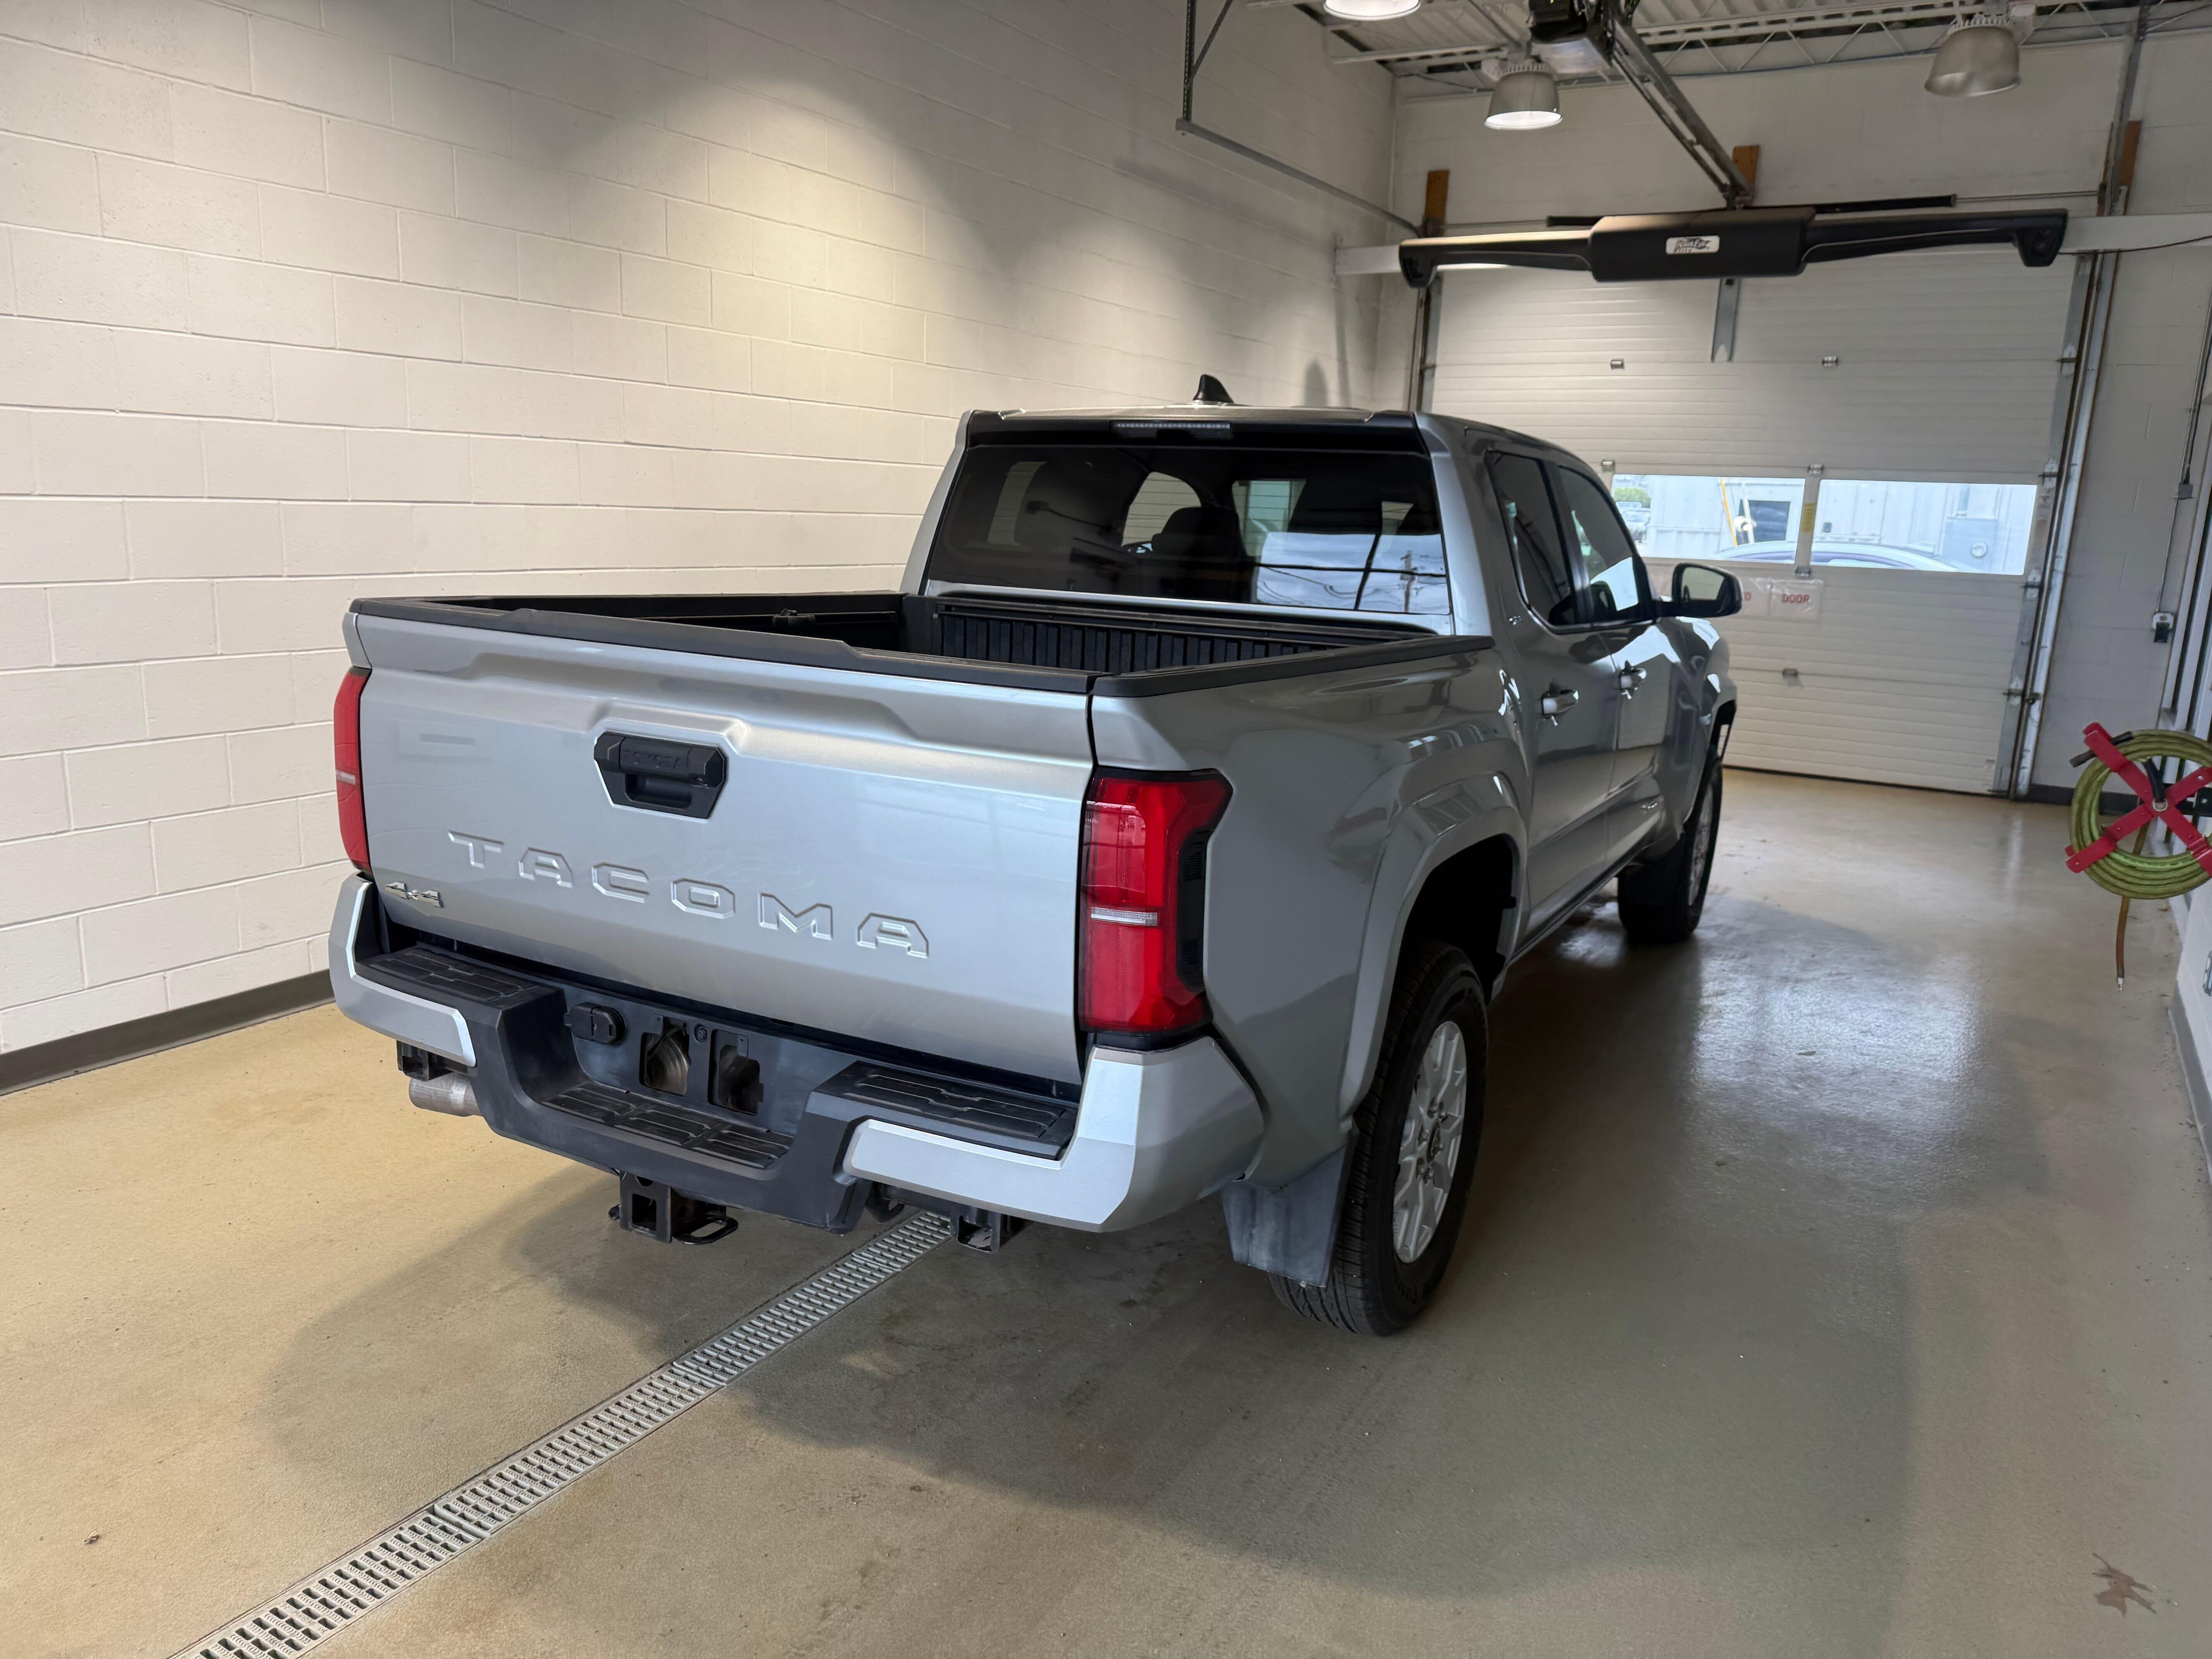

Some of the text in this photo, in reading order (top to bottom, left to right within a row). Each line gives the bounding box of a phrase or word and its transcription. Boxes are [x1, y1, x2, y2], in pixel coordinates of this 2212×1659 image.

[1782, 594, 1809, 603] DOOR
[622, 749, 685, 770] TOYOTA
[448, 830, 929, 959] TACOMA
